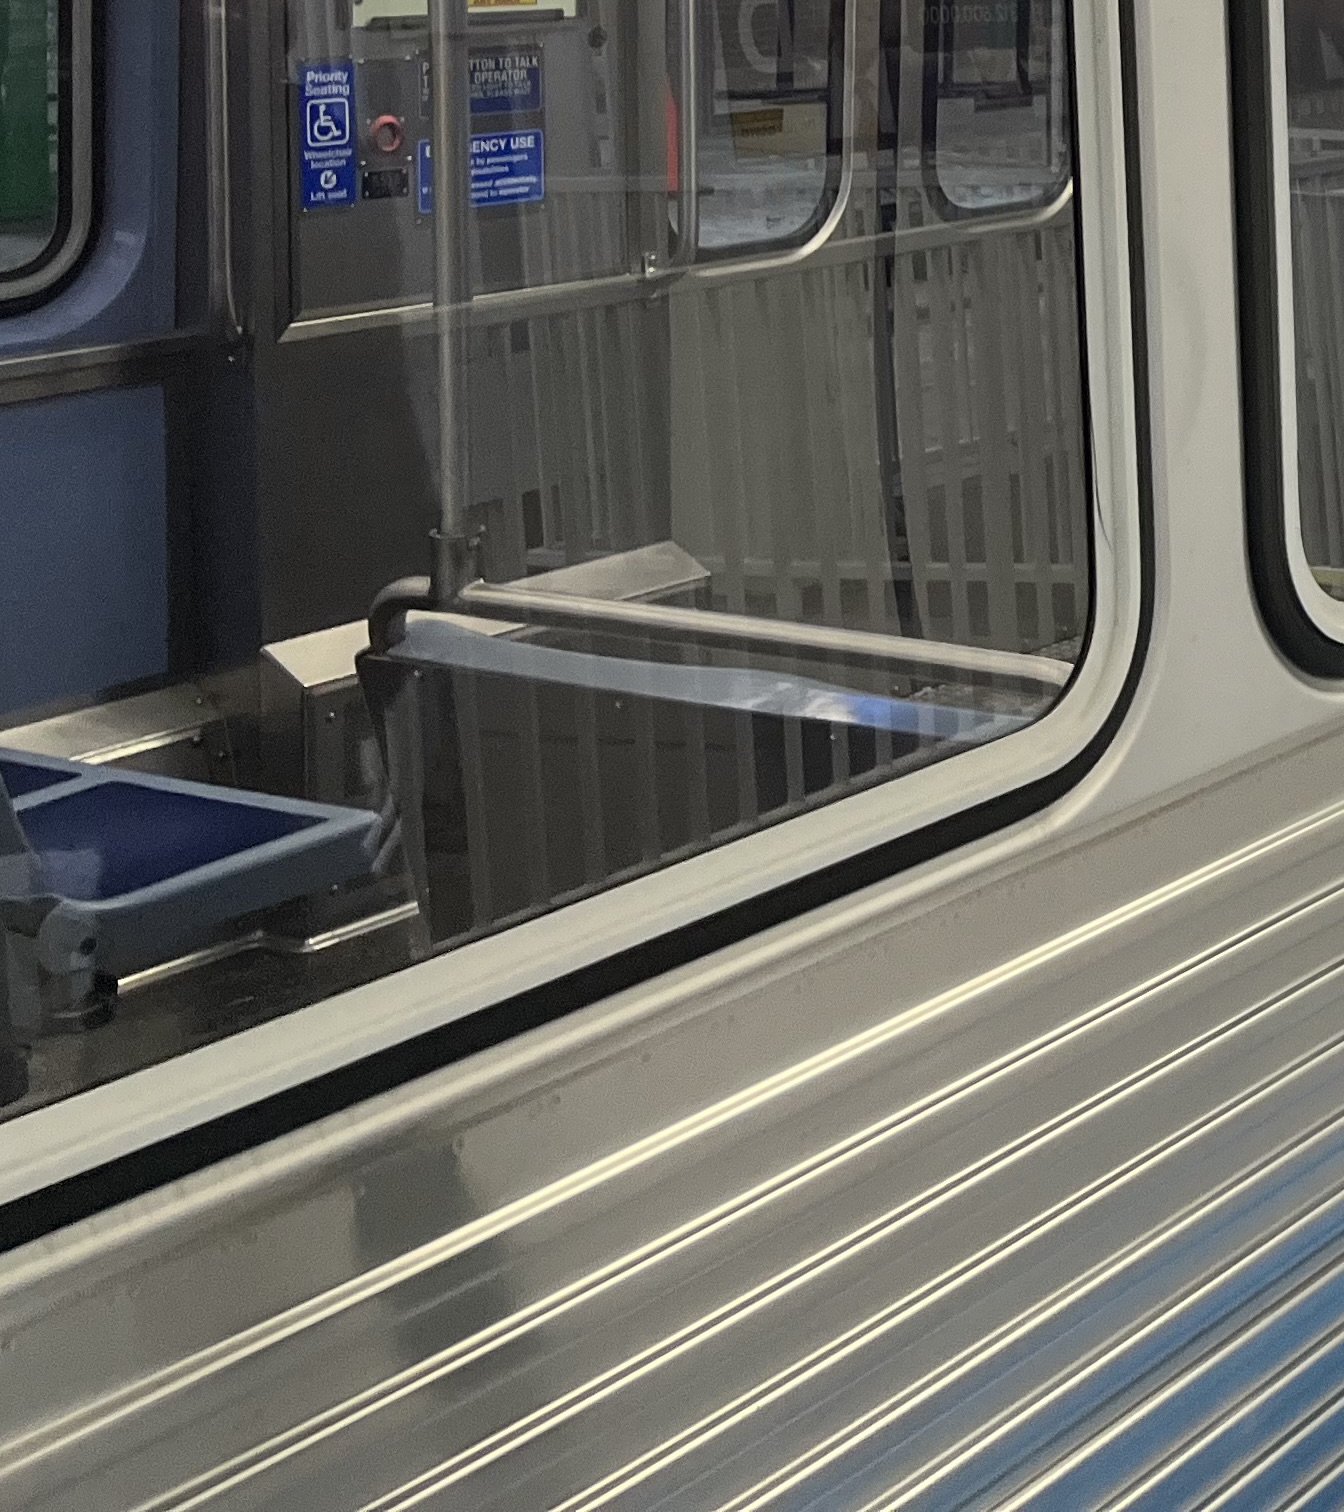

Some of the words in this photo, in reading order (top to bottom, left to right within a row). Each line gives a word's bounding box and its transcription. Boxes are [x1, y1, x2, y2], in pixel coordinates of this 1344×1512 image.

[499, 57, 512, 69] TO
[515, 55, 539, 68] TALK
[306, 70, 349, 85] Priority
[474, 68, 527, 84] OPERATOR
[305, 84, 350, 97] Seating
[511, 135, 535, 150] USE
